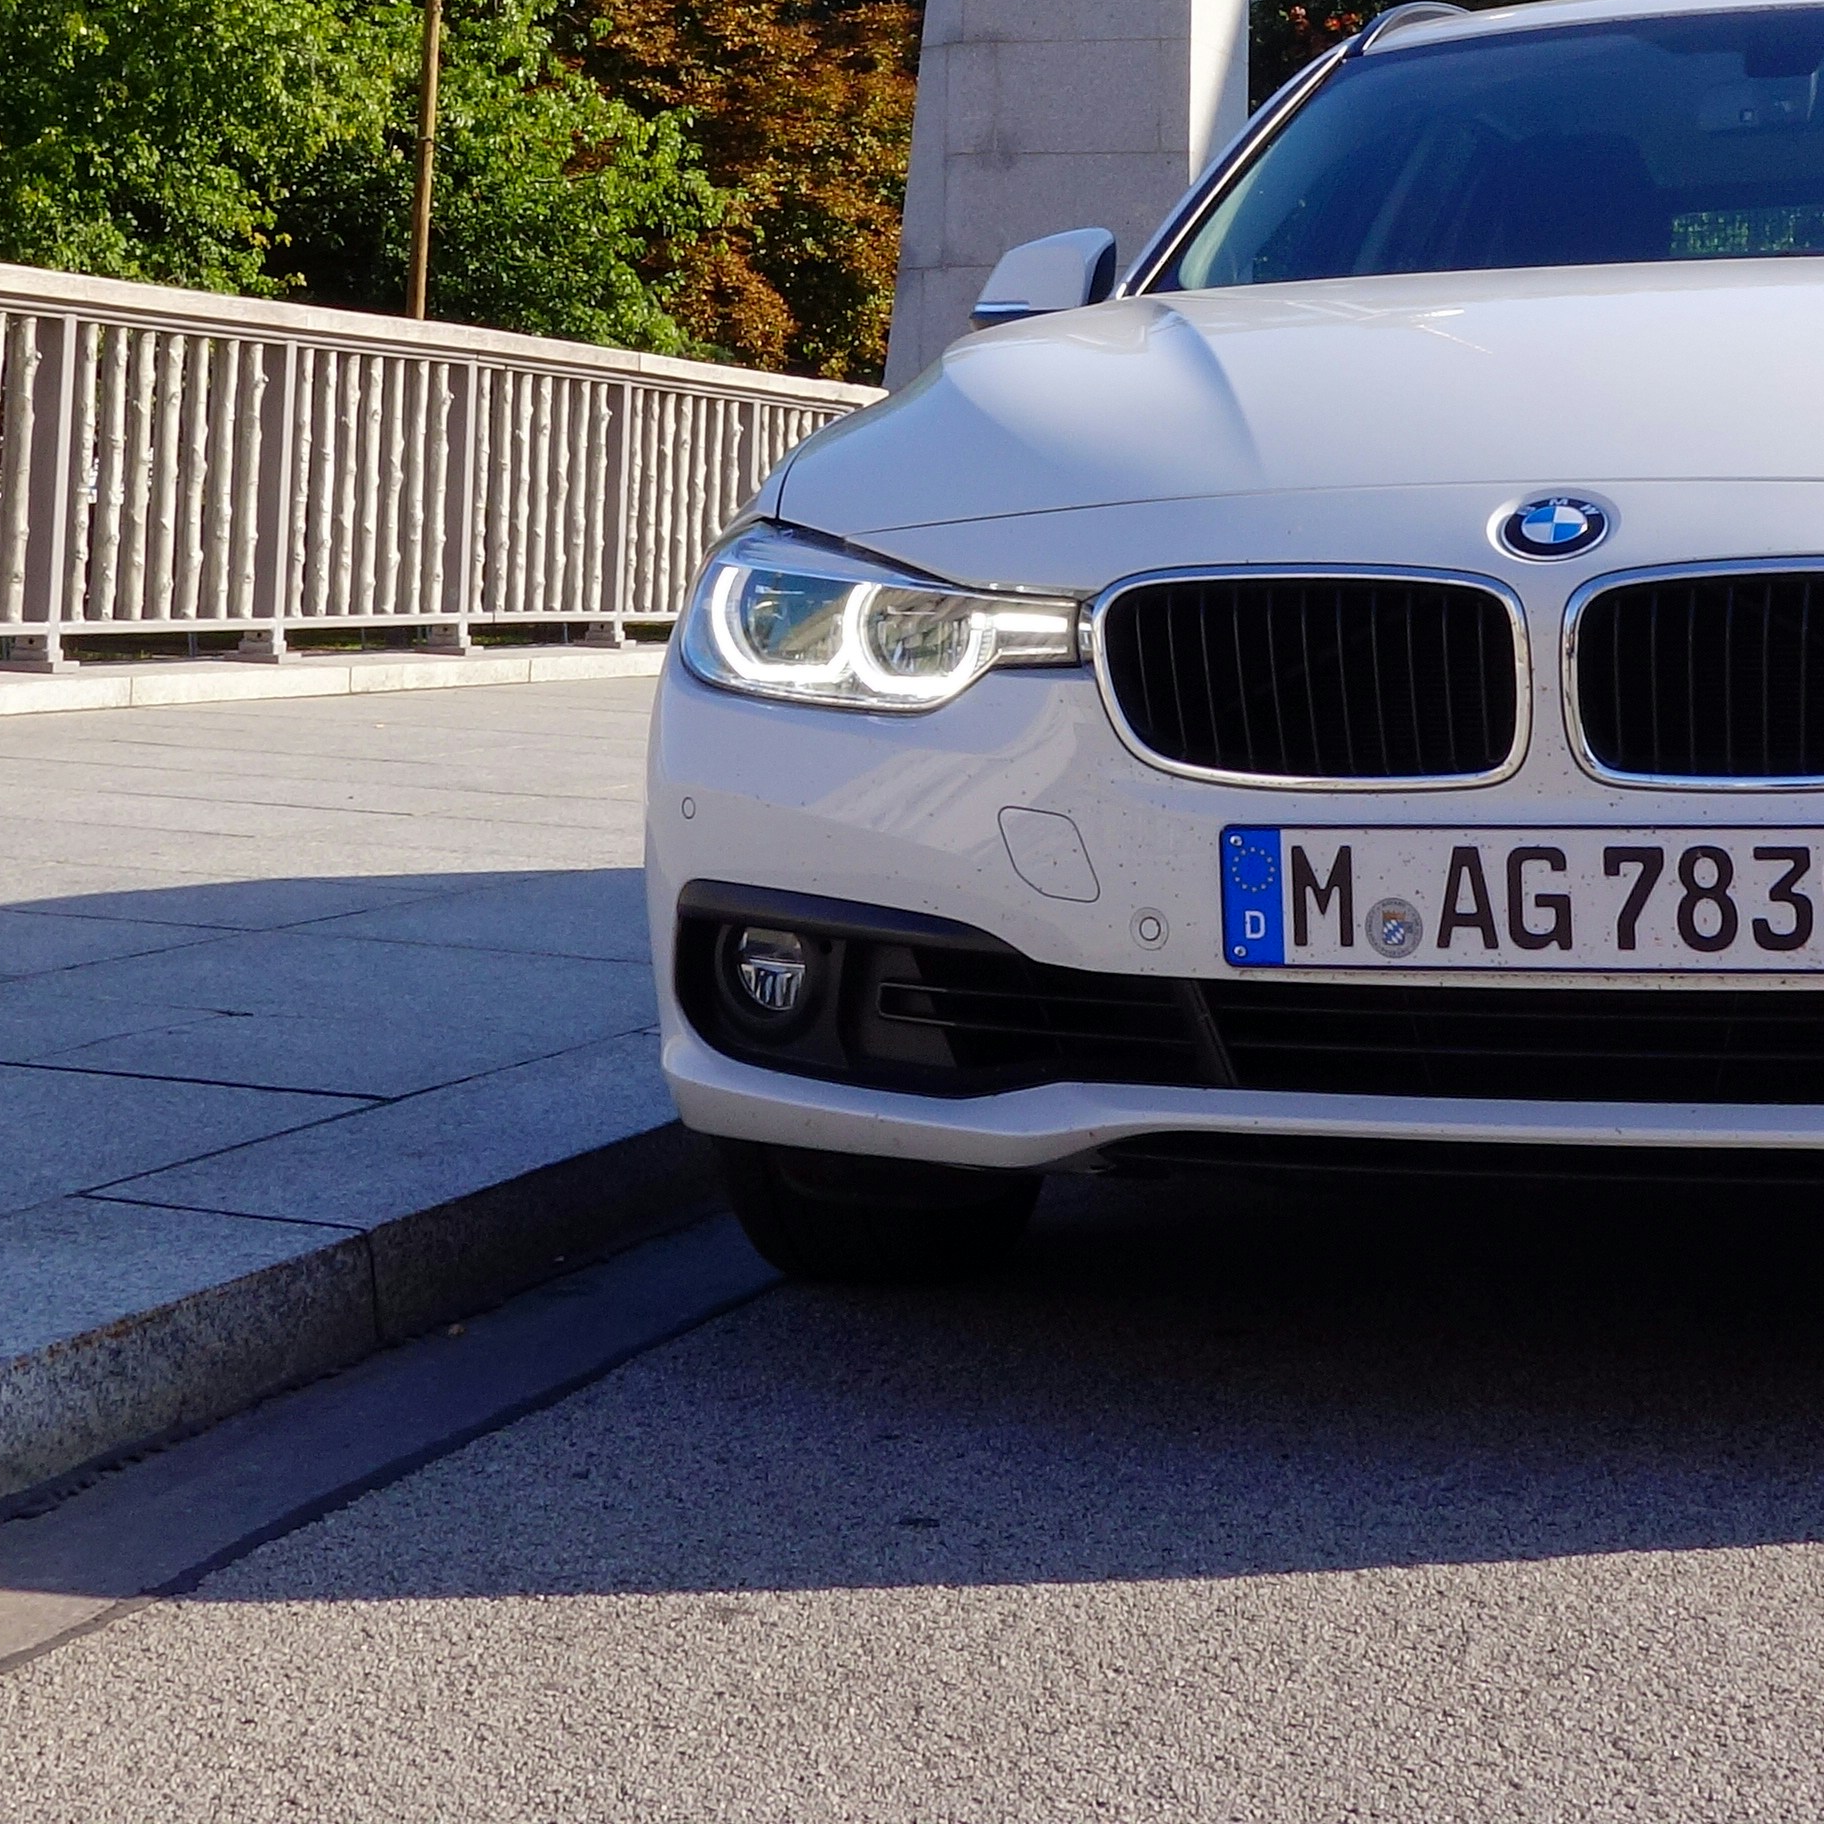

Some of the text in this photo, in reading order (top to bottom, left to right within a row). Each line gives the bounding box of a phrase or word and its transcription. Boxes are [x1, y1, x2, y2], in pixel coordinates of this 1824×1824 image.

[1516, 497, 1600, 516] BMW
[1245, 910, 1266, 939] D
[1291, 845, 1353, 946] M
[1437, 846, 1572, 951] AG
